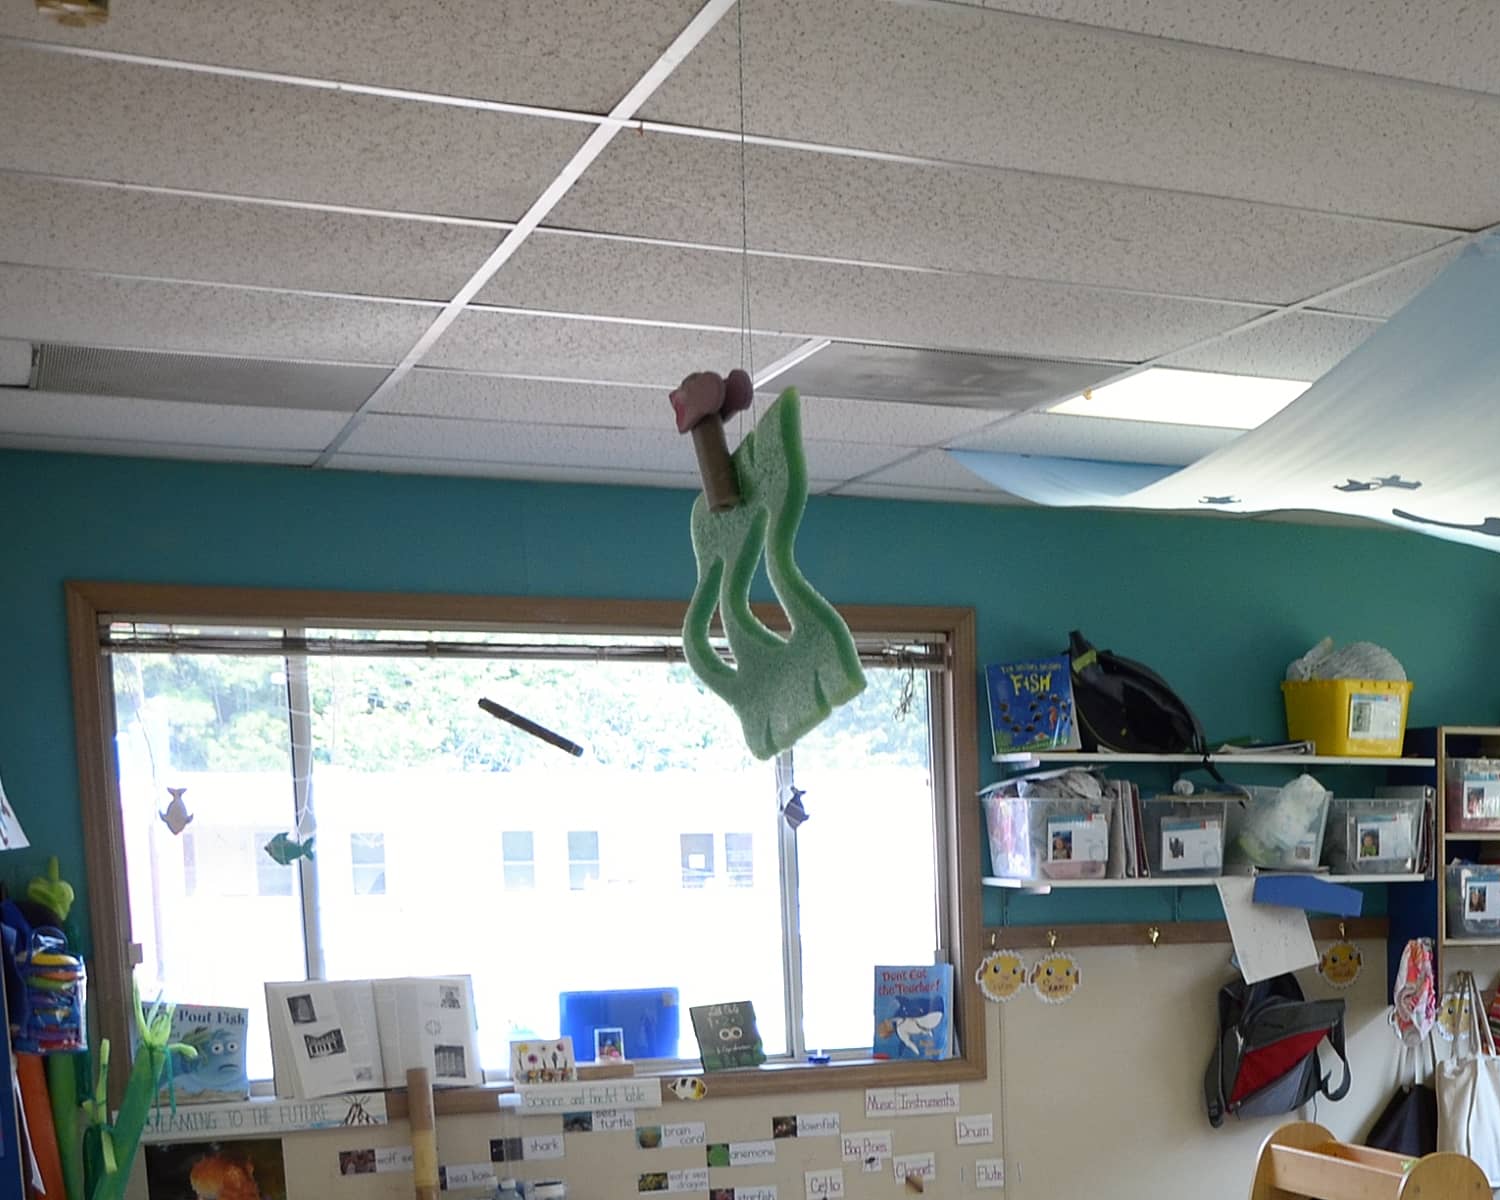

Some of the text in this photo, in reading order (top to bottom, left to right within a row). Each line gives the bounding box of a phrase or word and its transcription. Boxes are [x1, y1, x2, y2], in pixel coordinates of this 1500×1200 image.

[228, 1109, 244, 1129] TO
[252, 1106, 273, 1127] THE
[280, 1103, 329, 1124] FUTURE
[600, 1112, 634, 1129] turtle
[959, 1120, 991, 1139] Drum
[529, 1138, 559, 1153] shark
[811, 1175, 841, 1194] Cello
